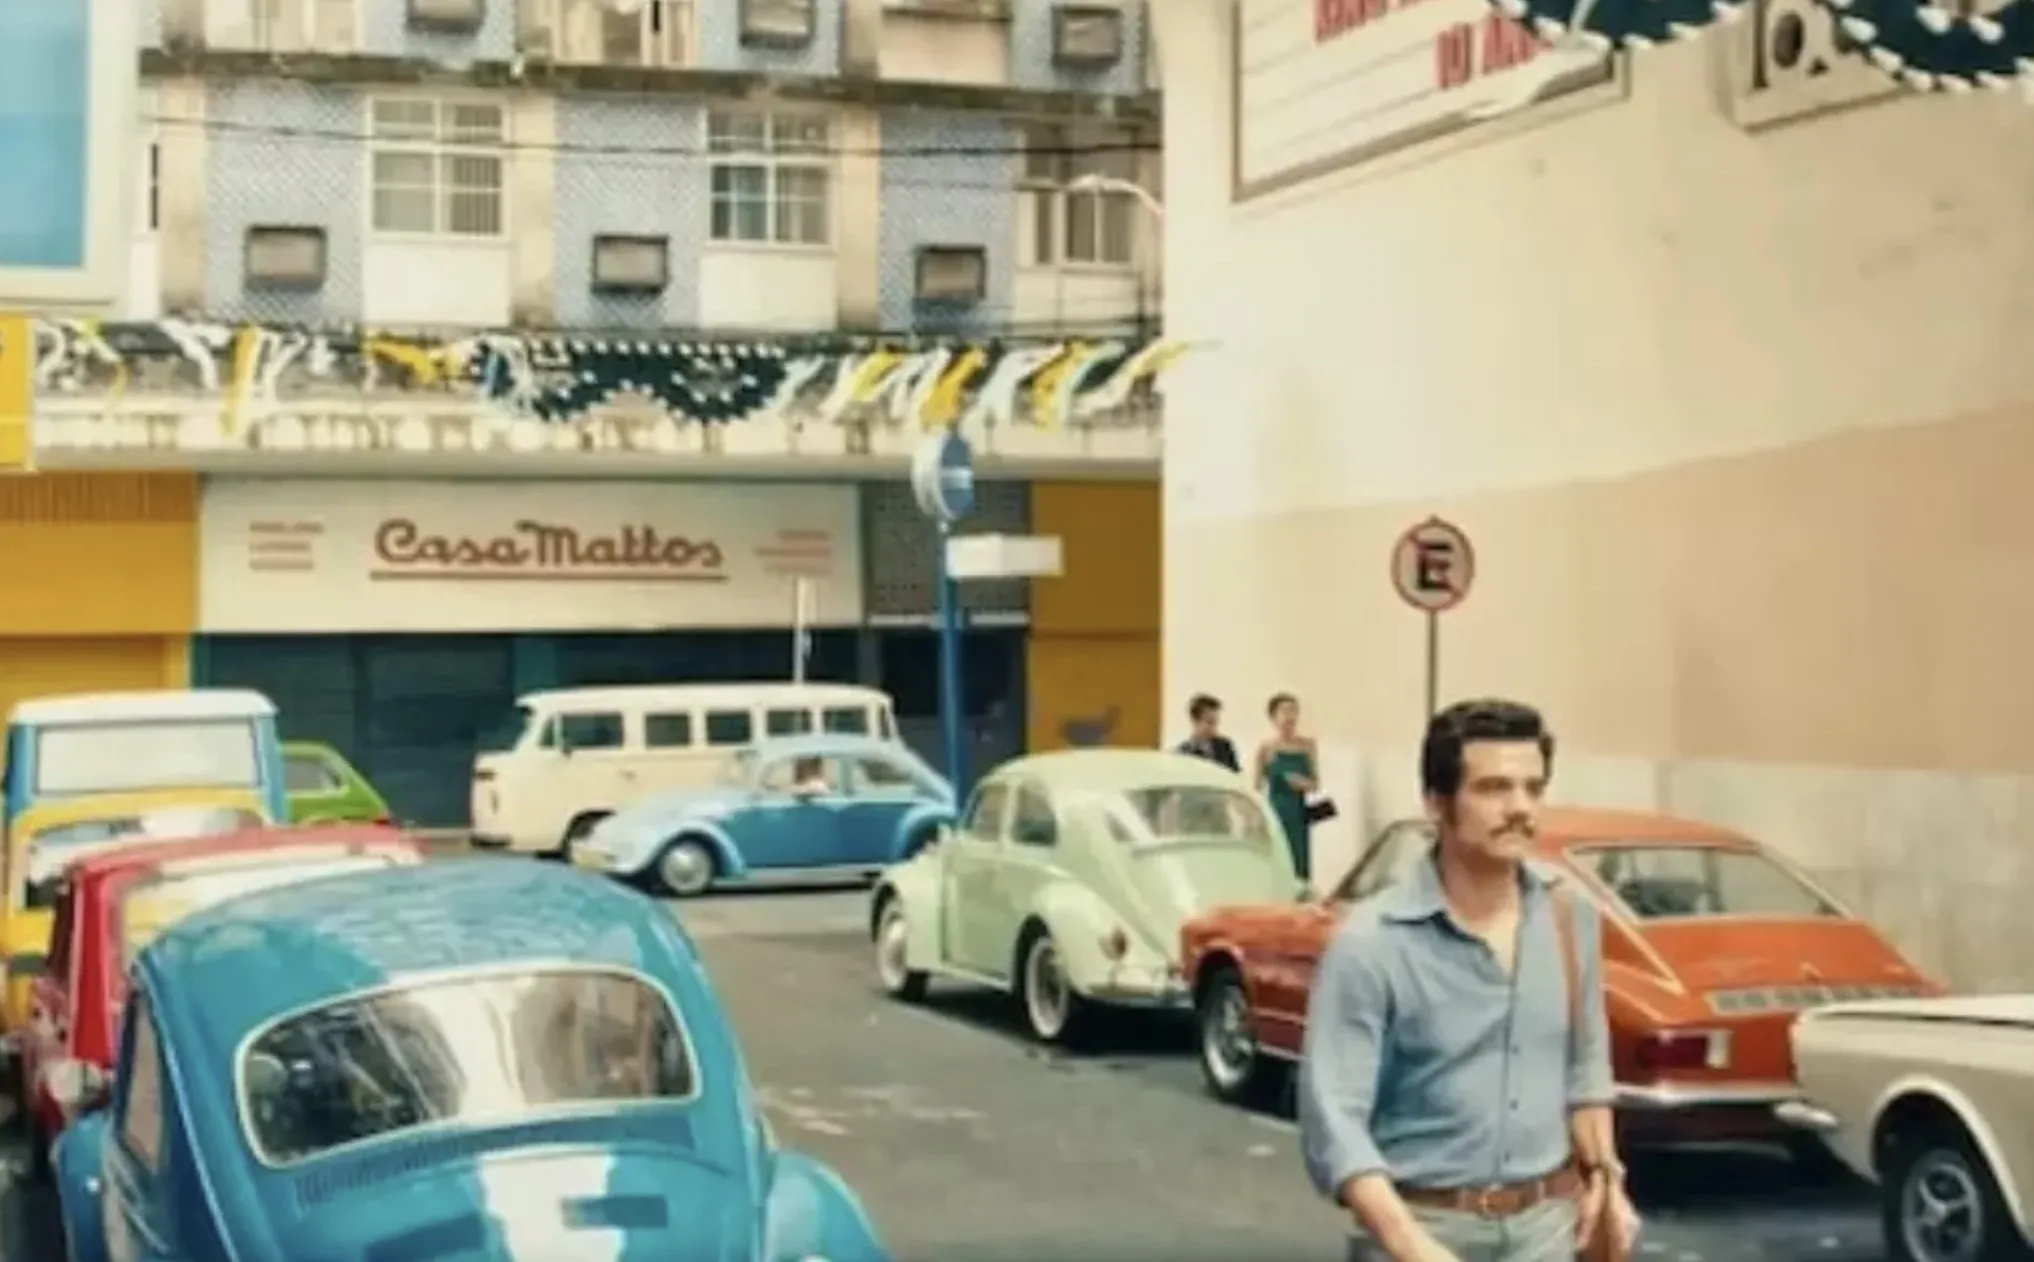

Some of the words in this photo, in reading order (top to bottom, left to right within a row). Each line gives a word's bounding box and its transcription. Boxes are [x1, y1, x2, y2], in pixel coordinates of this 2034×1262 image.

[374, 518, 531, 565] Casa
[513, 519, 723, 567] Mattos
[1416, 541, 1453, 590] E
